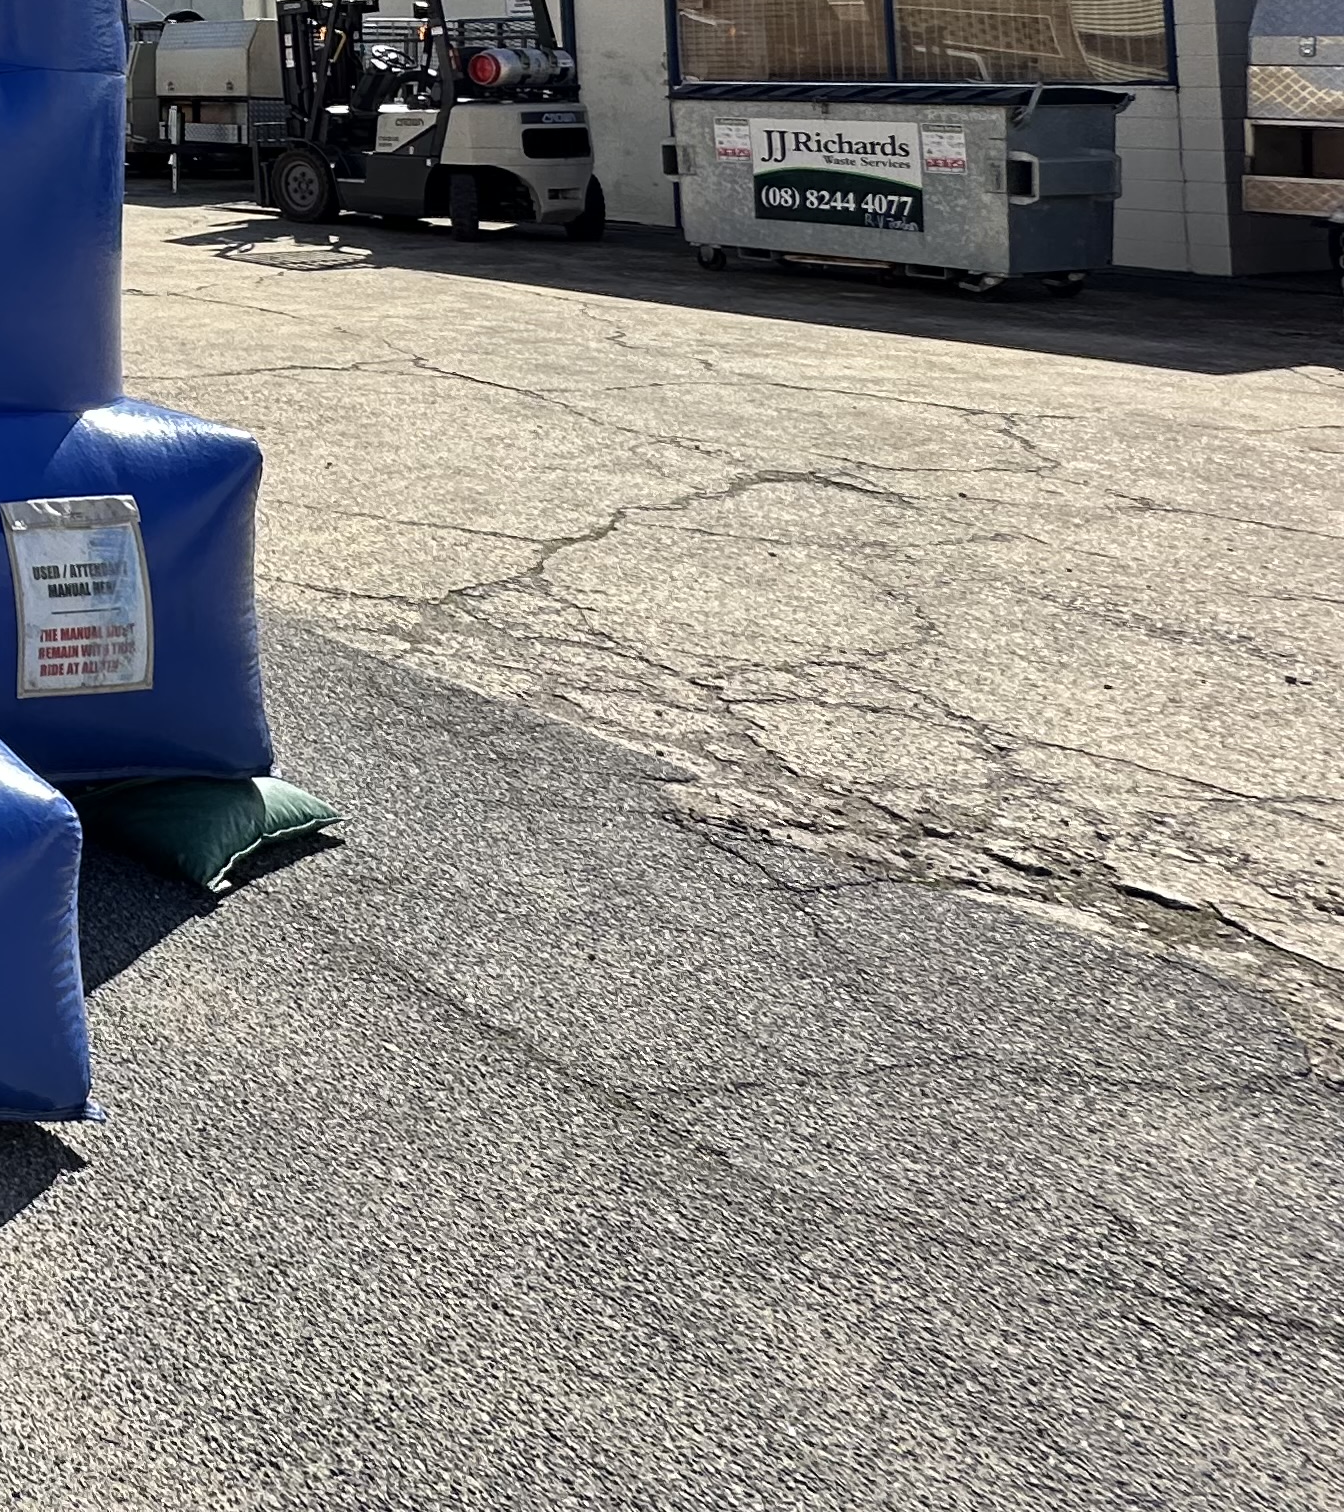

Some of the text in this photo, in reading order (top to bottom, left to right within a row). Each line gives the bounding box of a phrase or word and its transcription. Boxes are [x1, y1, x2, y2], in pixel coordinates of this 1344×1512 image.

[761, 128, 911, 163] JJ Richards
[822, 155, 911, 169] Waste Services
[761, 185, 913, 216] (08) 8244 4077
[32, 565, 60, 580] USER
[48, 581, 91, 598] MANUAL
[38, 644, 79, 660] REMAIN
[40, 663, 64, 677] RIDE
[66, 662, 80, 675] AT
